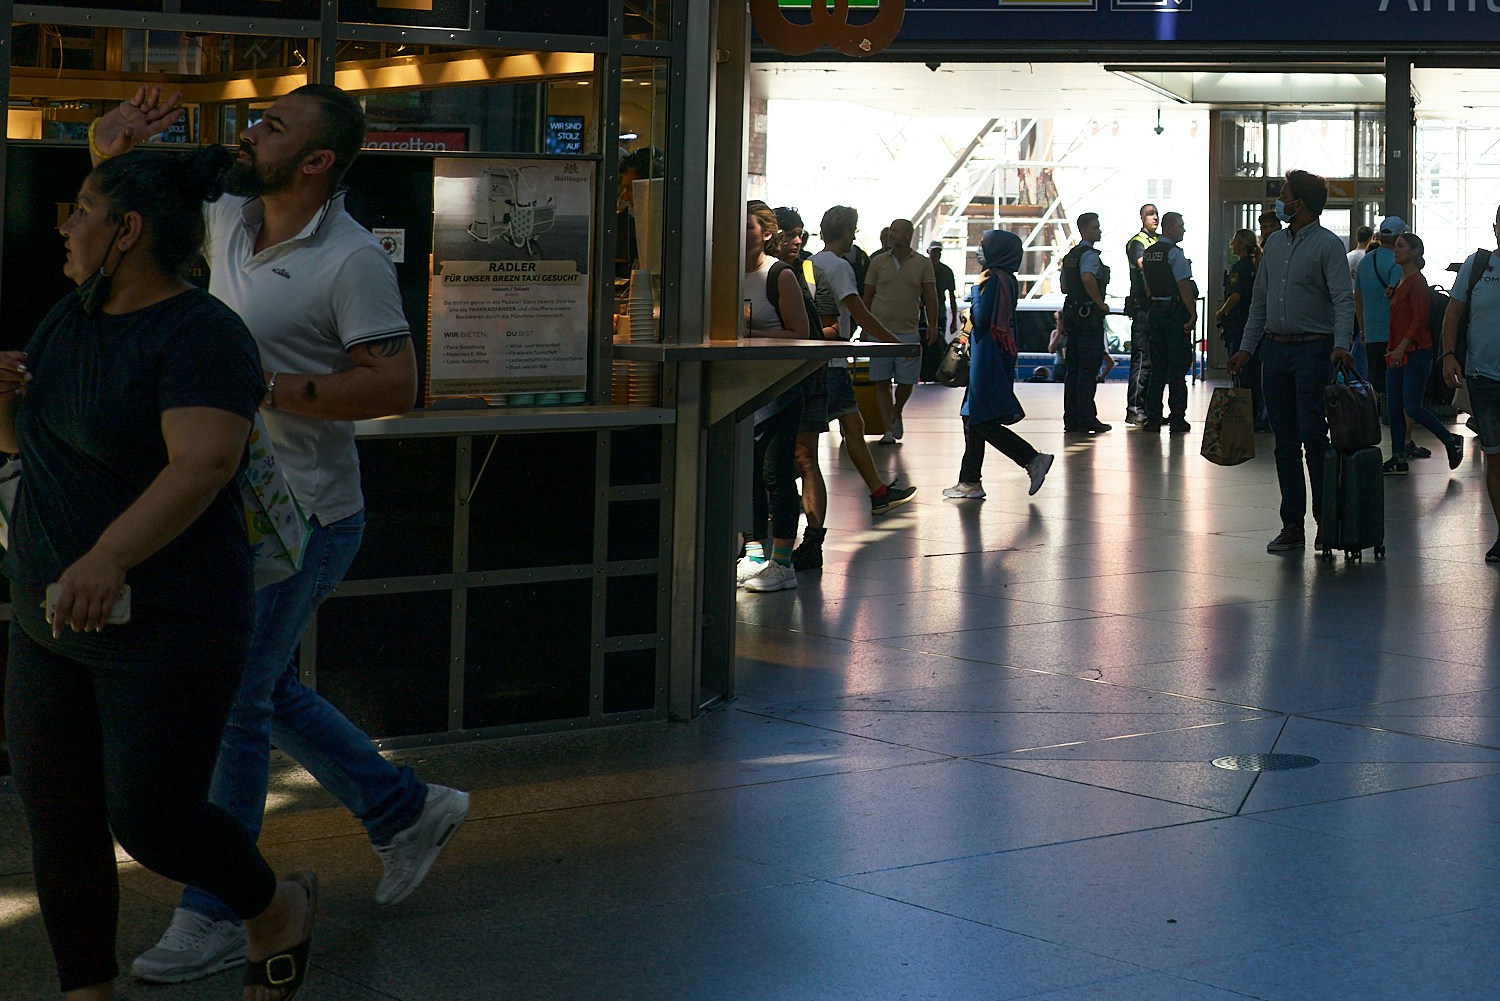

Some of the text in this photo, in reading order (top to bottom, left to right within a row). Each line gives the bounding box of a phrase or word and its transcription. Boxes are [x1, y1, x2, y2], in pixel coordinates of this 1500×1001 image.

[550, 122, 582, 130] WIR SIND
[557, 132, 580, 140] STOLZ
[566, 142, 581, 150] AUF
[489, 263, 536, 271] RADLER
[444, 274, 461, 282] FÜR
